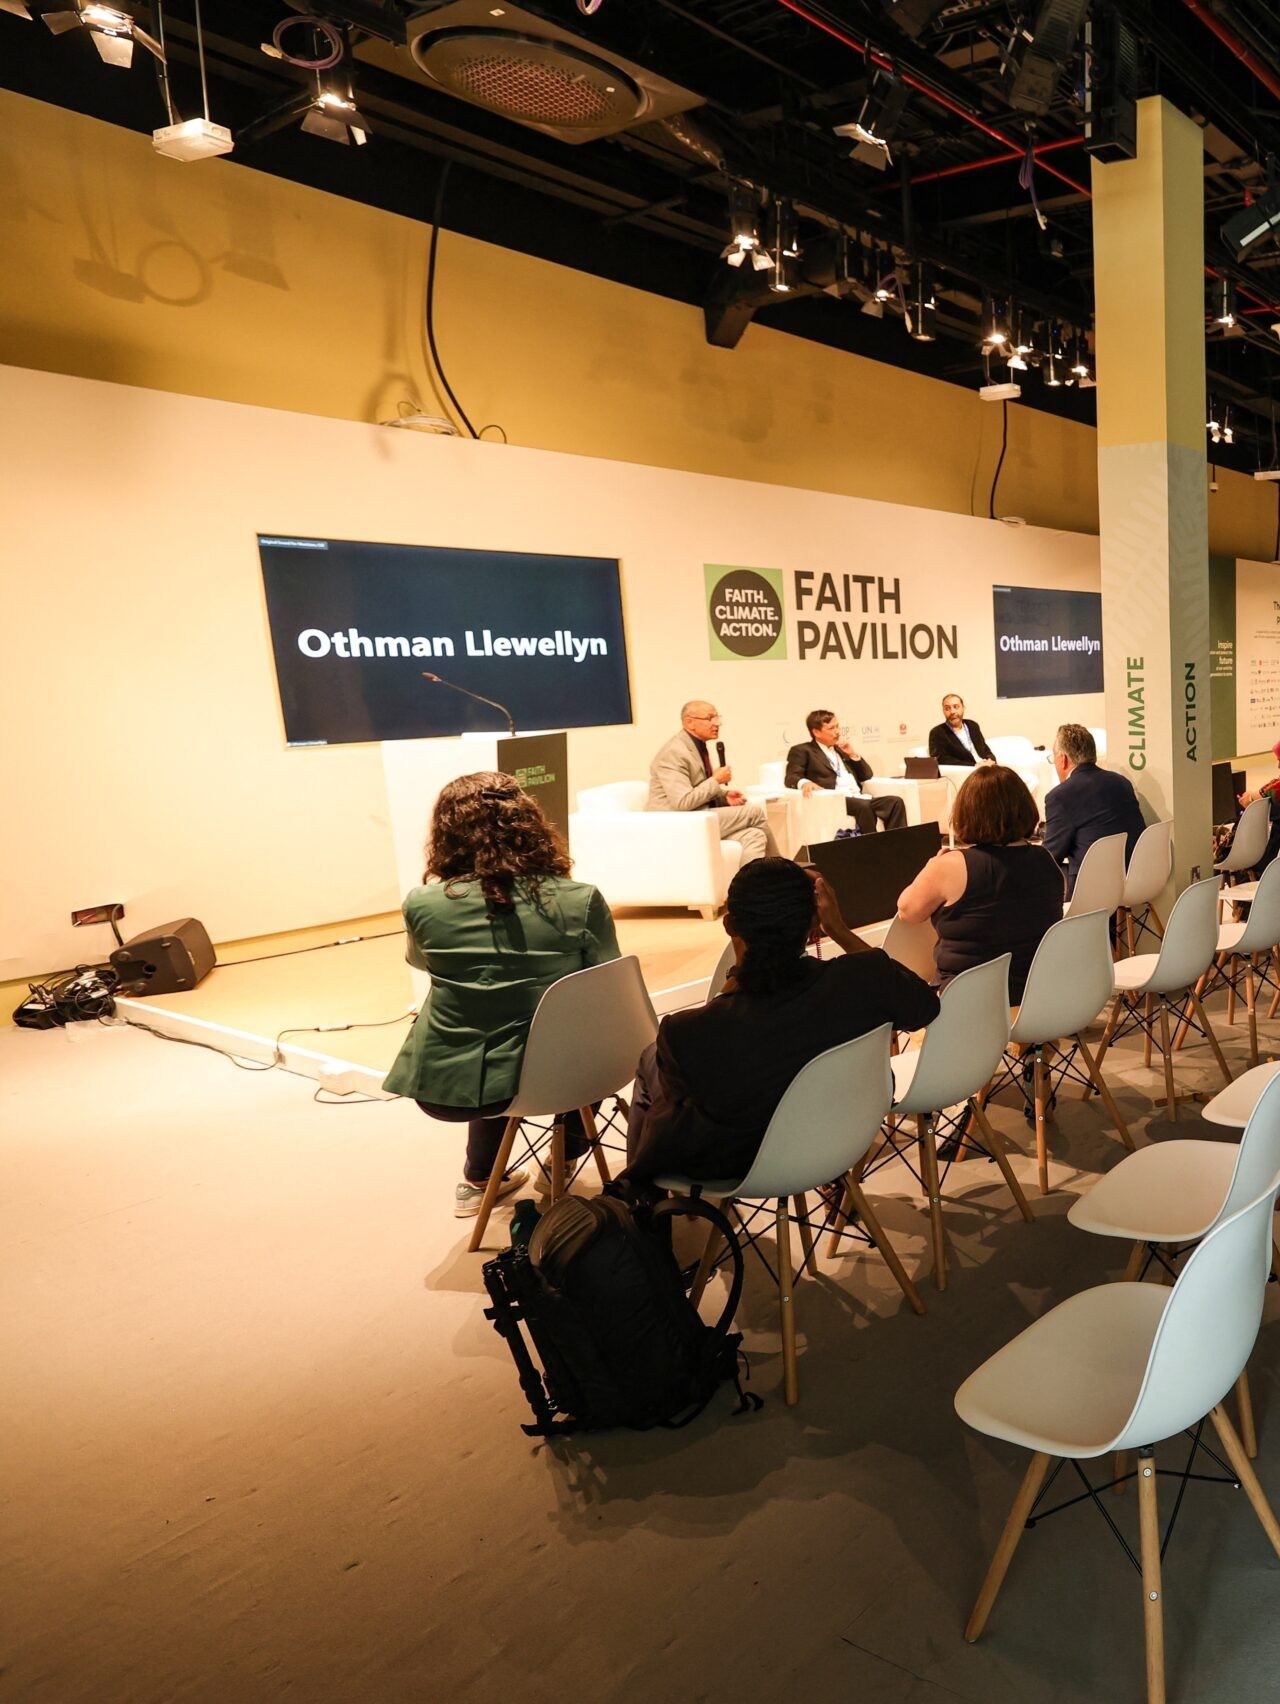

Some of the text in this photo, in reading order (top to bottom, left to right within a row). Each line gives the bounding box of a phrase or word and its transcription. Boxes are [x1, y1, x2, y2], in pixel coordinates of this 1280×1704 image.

[724, 588, 768, 604] FAITH.
[793, 570, 901, 614] FAITH
[715, 605, 779, 621] CLIMATE.
[720, 622, 777, 637] ACTION.
[297, 628, 608, 663] Othman Llewellyn
[797, 620, 958, 660] PAVILION
[999, 635, 1101, 655] Othman Llewellyn
[1126, 657, 1147, 771] CLIMATE
[1184, 663, 1197, 762] ACTION
